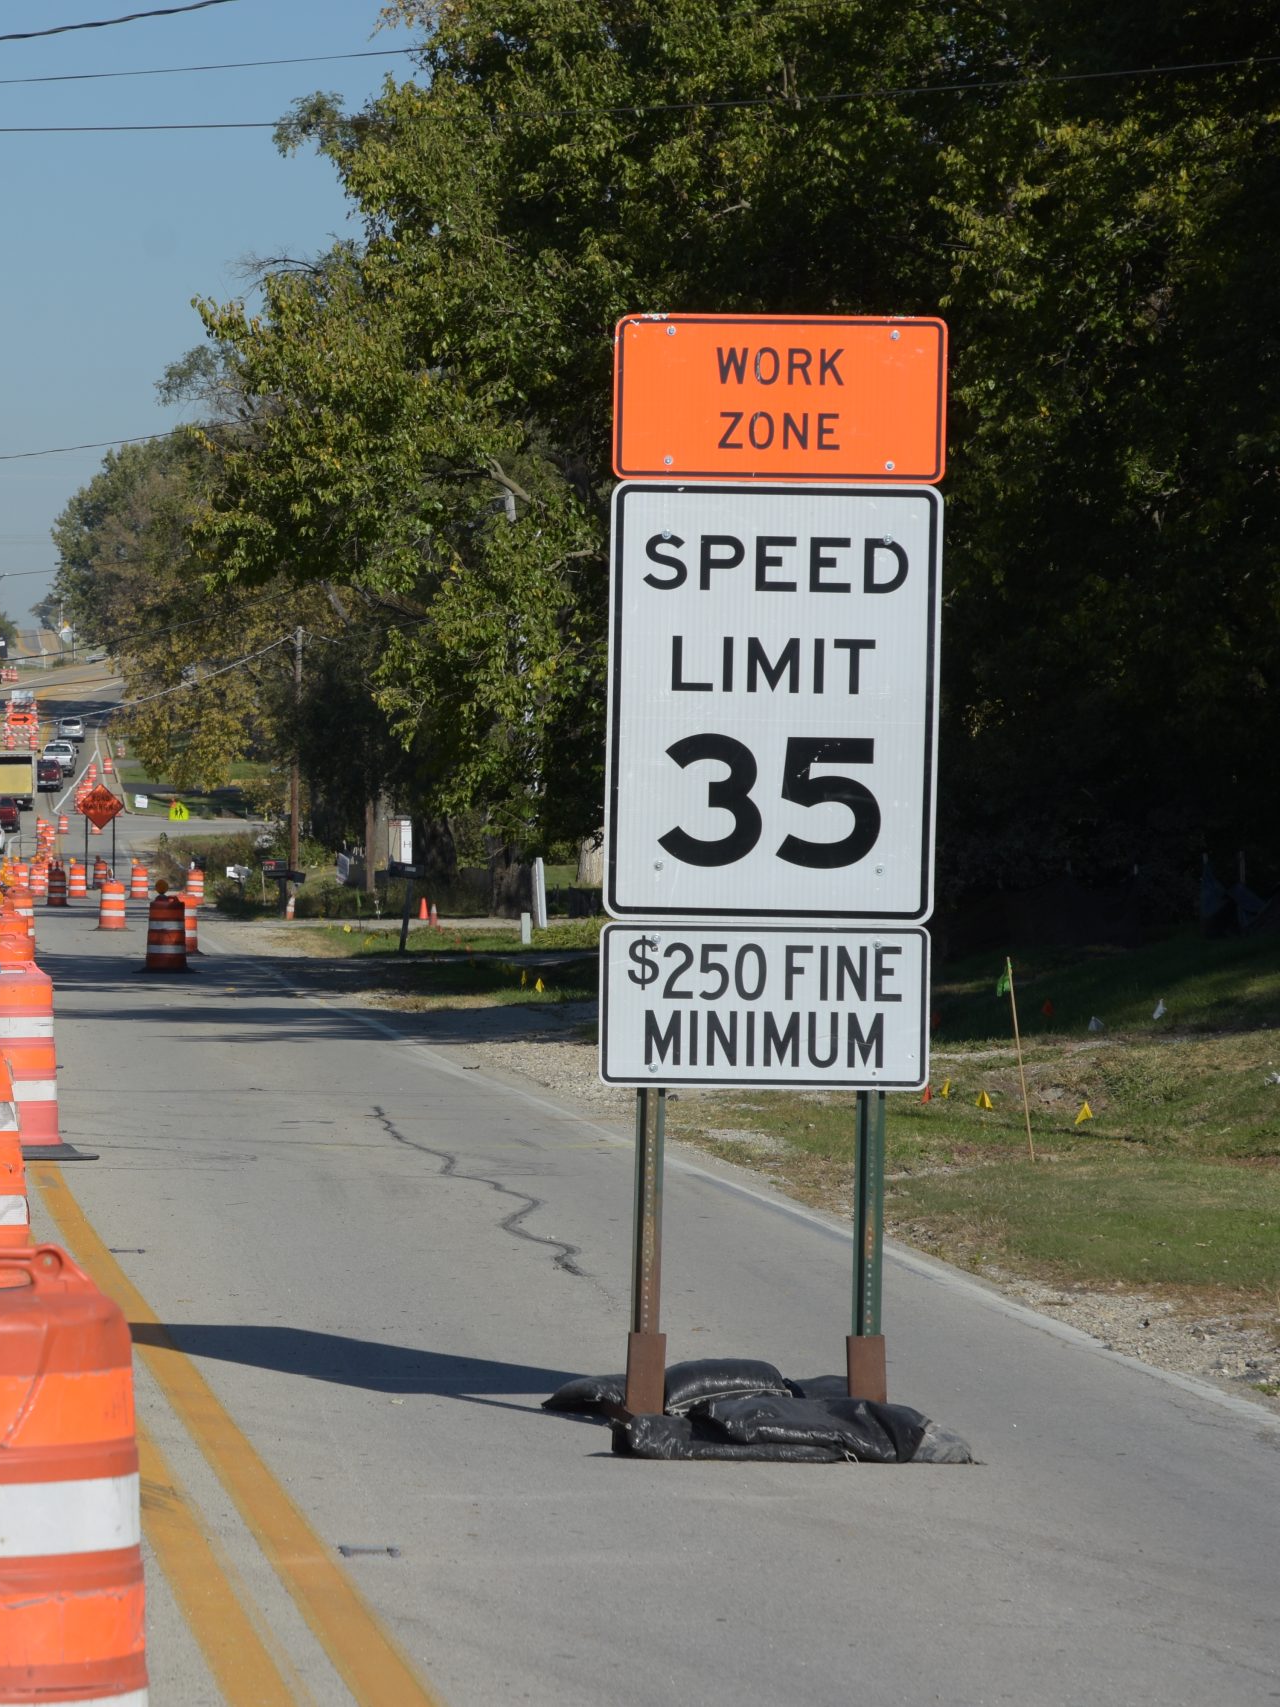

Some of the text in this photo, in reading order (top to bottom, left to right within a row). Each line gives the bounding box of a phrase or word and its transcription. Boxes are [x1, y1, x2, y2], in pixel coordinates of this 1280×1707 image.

[716, 346, 846, 387] WORK
[717, 411, 841, 451] ZONE
[642, 532, 910, 594] SPEED
[671, 635, 876, 695] LIMIT
[657, 732, 882, 870] 35
[627, 934, 903, 1003] $250 FINE
[643, 1009, 885, 1069] MINIMUM
